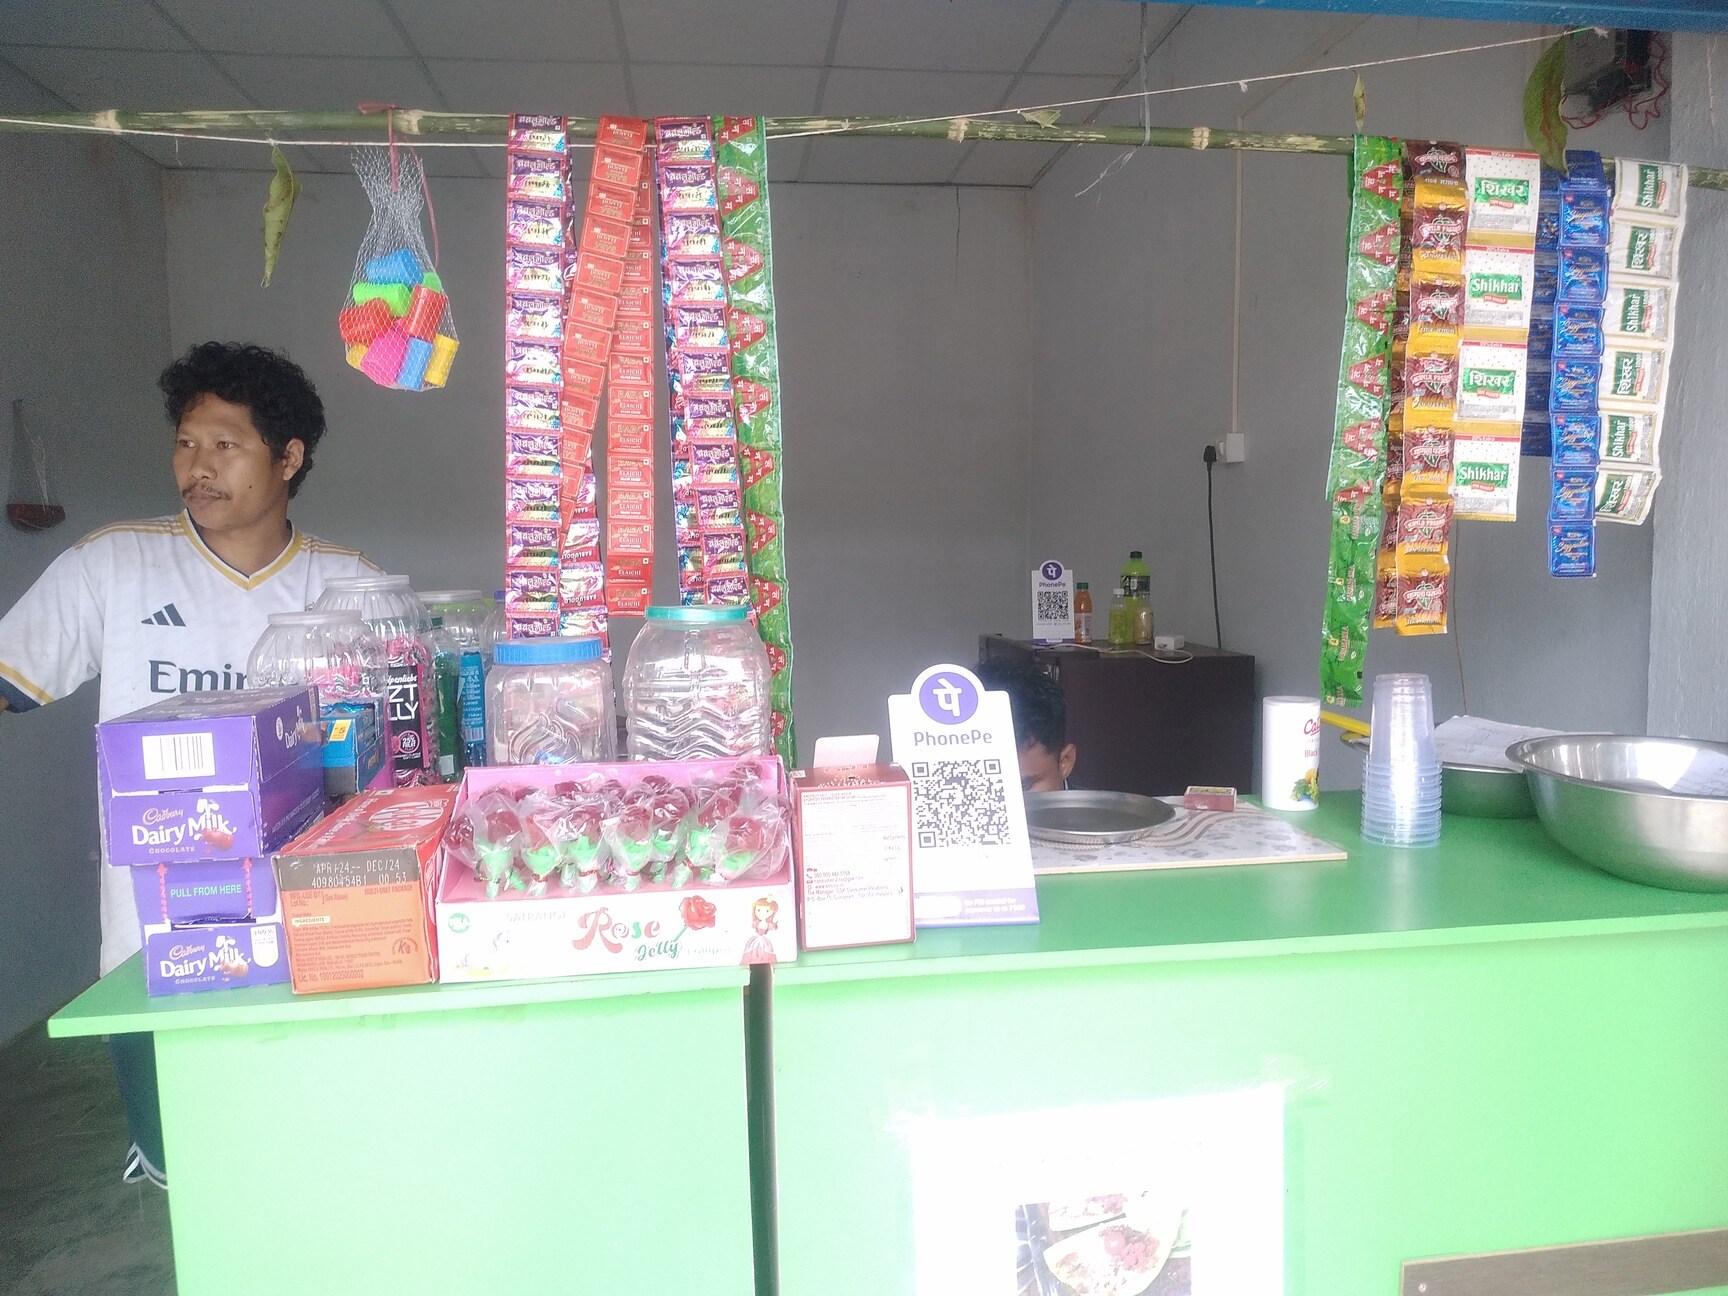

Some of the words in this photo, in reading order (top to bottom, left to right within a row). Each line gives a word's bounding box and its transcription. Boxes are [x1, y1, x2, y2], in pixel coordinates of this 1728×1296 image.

[1480, 180, 1524, 197] शिखर
[1642, 169, 1656, 207] Shikhar
[1632, 233, 1648, 268] शिखर
[1472, 278, 1519, 293] Shikhar
[1626, 294, 1640, 332] Shikhar
[1470, 371, 1510, 387] शिखर
[1617, 358, 1633, 394] शिखर
[1612, 421, 1626, 458] Shikhar
[1459, 467, 1506, 482] Shikhar
[1047, 564, 1057, 578] पे
[388, 674, 417, 685] lpenliebe
[932, 678, 962, 717] पे
[914, 730, 992, 746] PhonePe
[142, 808, 184, 826] Cadbury
[132, 823, 186, 846] Dairy
[188, 811, 237, 839] Milk
[149, 846, 195, 854] CHOCOLATE
[366, 859, 400, 872] DEC/24
[170, 888, 192, 898] PULL
[193, 886, 218, 897] FROM
[220, 884, 242, 895] HERE
[392, 884, 413, 892] PACKAGE
[572, 907, 661, 954] Rose
[169, 944, 205, 959] Cadbury
[635, 940, 682, 961] Jelly
[160, 957, 212, 978] Dairy
[208, 944, 246, 971] Milk
[175, 976, 215, 984] CHOCOLATE
